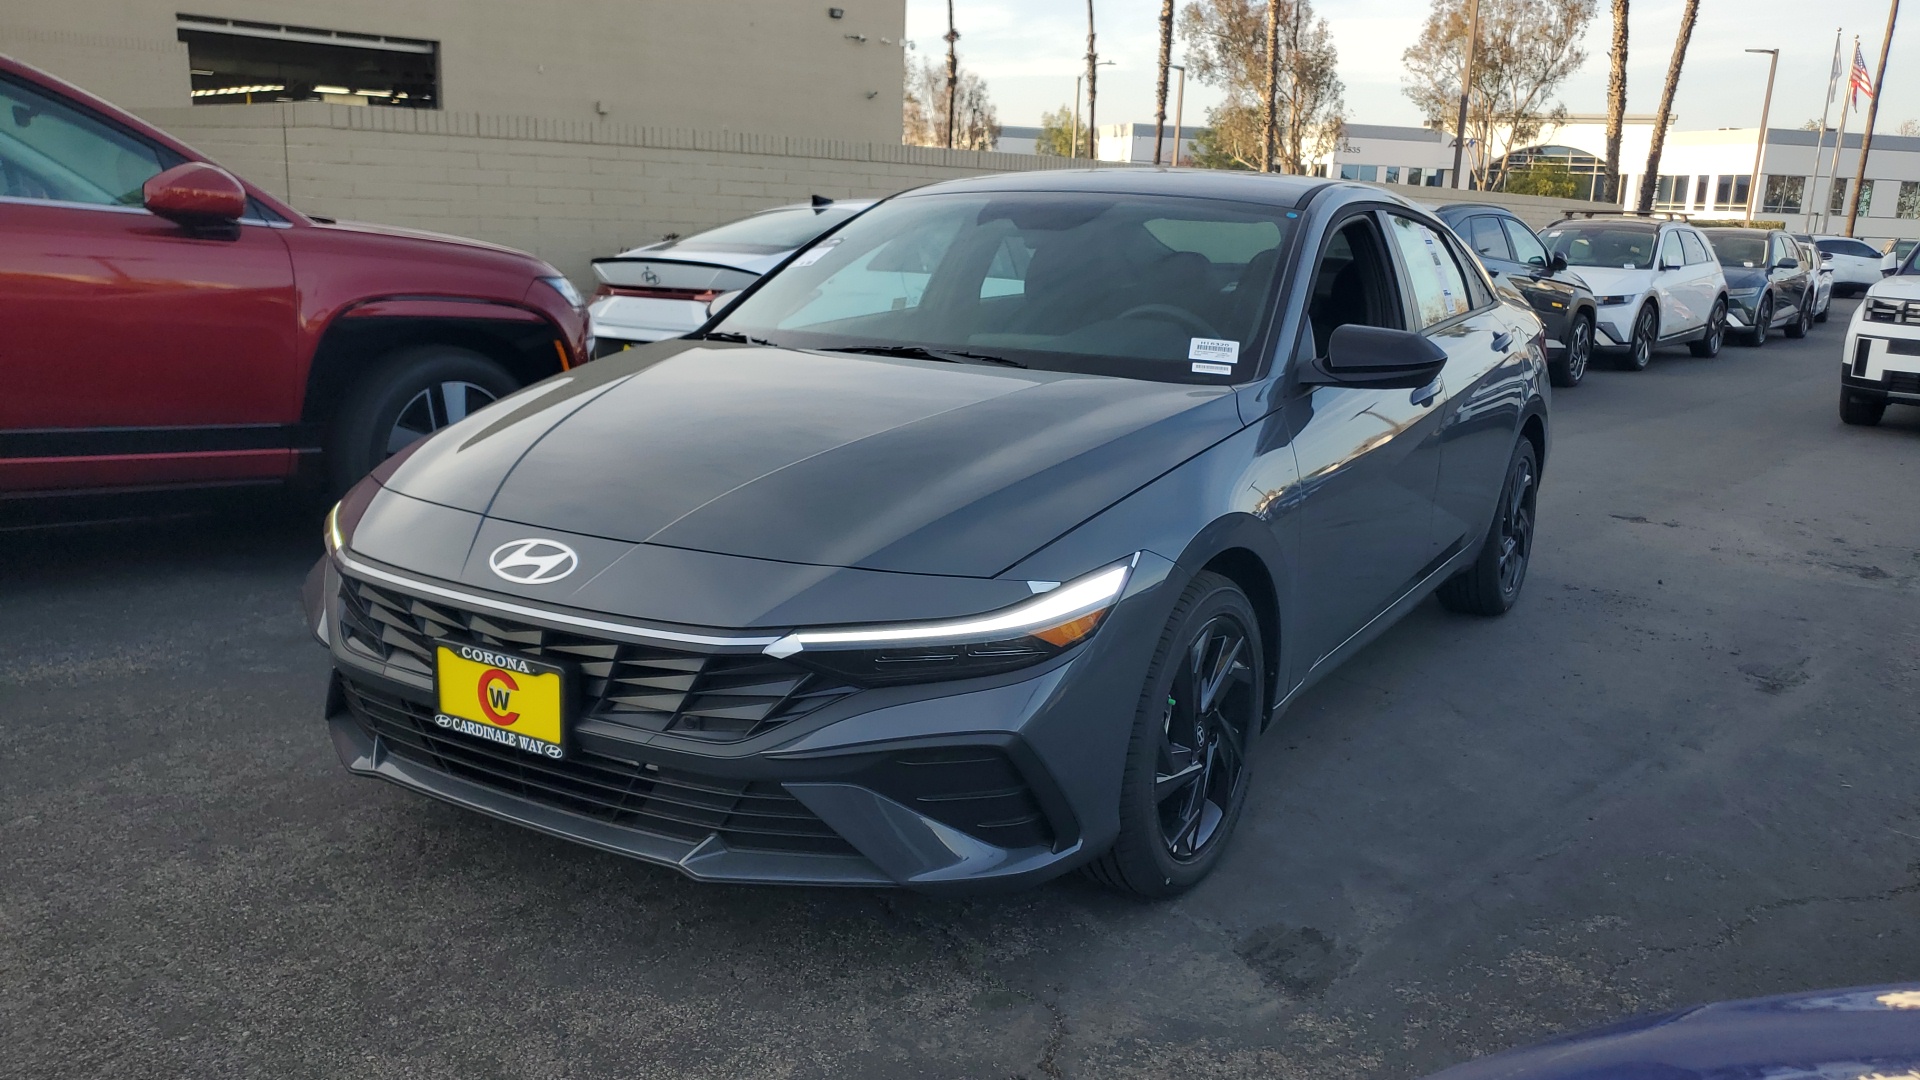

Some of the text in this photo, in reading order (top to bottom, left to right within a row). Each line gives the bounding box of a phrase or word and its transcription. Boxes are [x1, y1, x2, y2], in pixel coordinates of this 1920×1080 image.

[461, 646, 530, 673] CORONA
[452, 718, 545, 755] CARDINALE WAY
